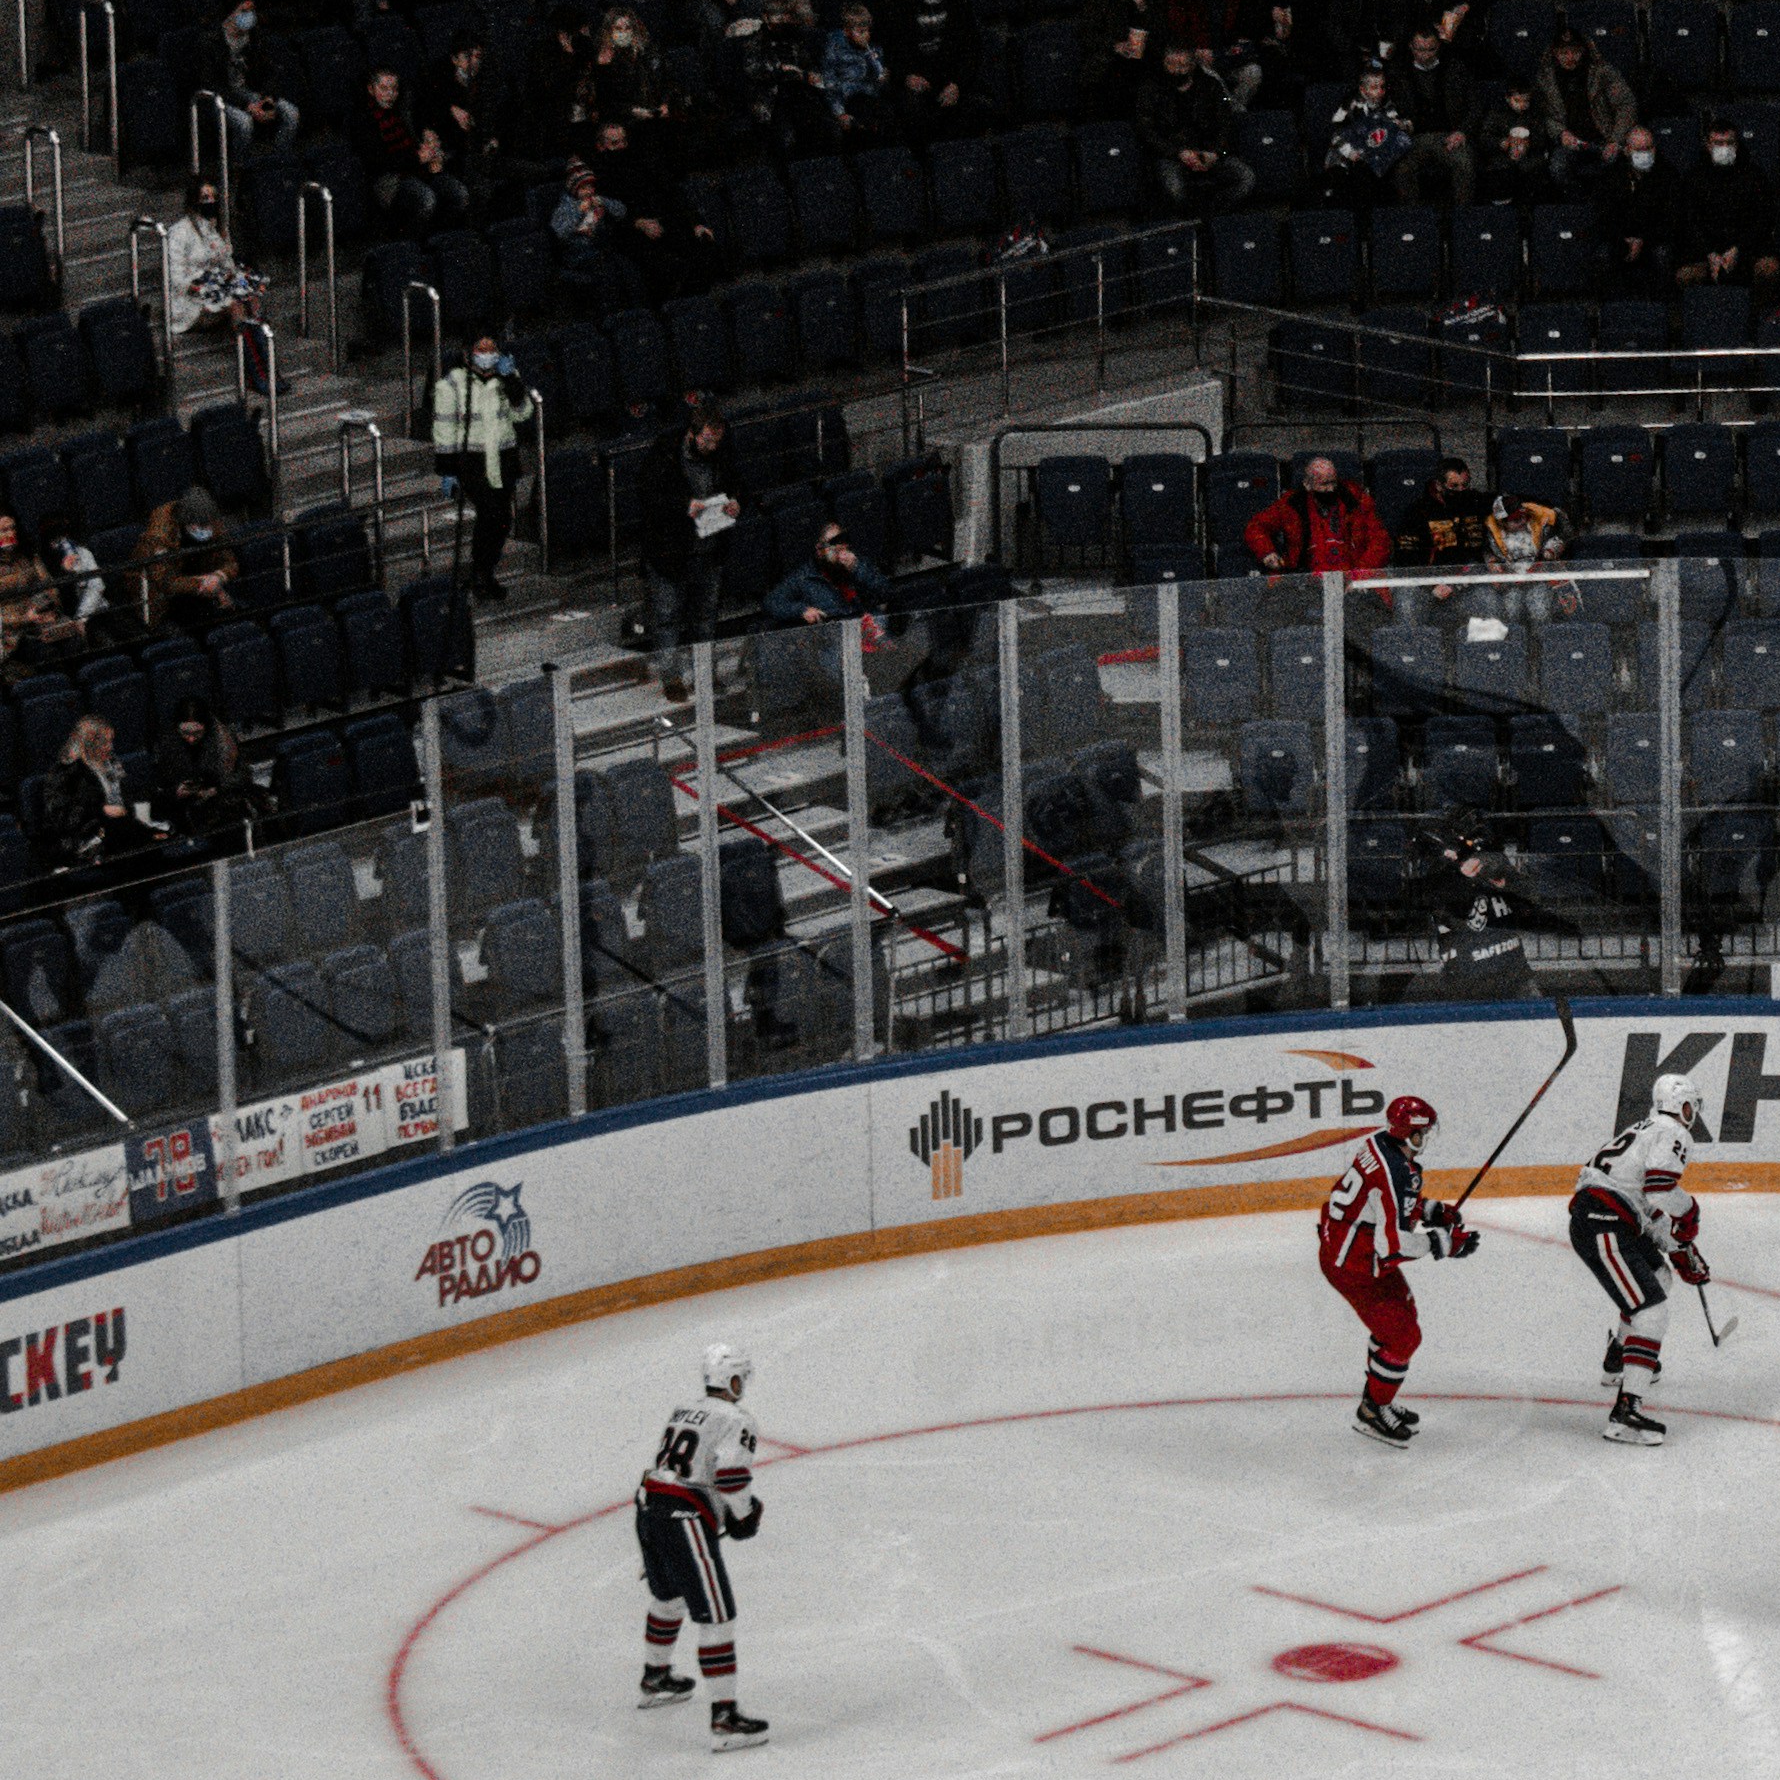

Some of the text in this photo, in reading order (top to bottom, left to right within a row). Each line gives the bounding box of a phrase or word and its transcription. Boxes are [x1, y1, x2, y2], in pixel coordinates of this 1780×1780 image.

[991, 1079, 1385, 1154] РОСНЕФТЬ
[413, 1228, 495, 1282] АВТО
[438, 1250, 541, 1307] РАДИО
